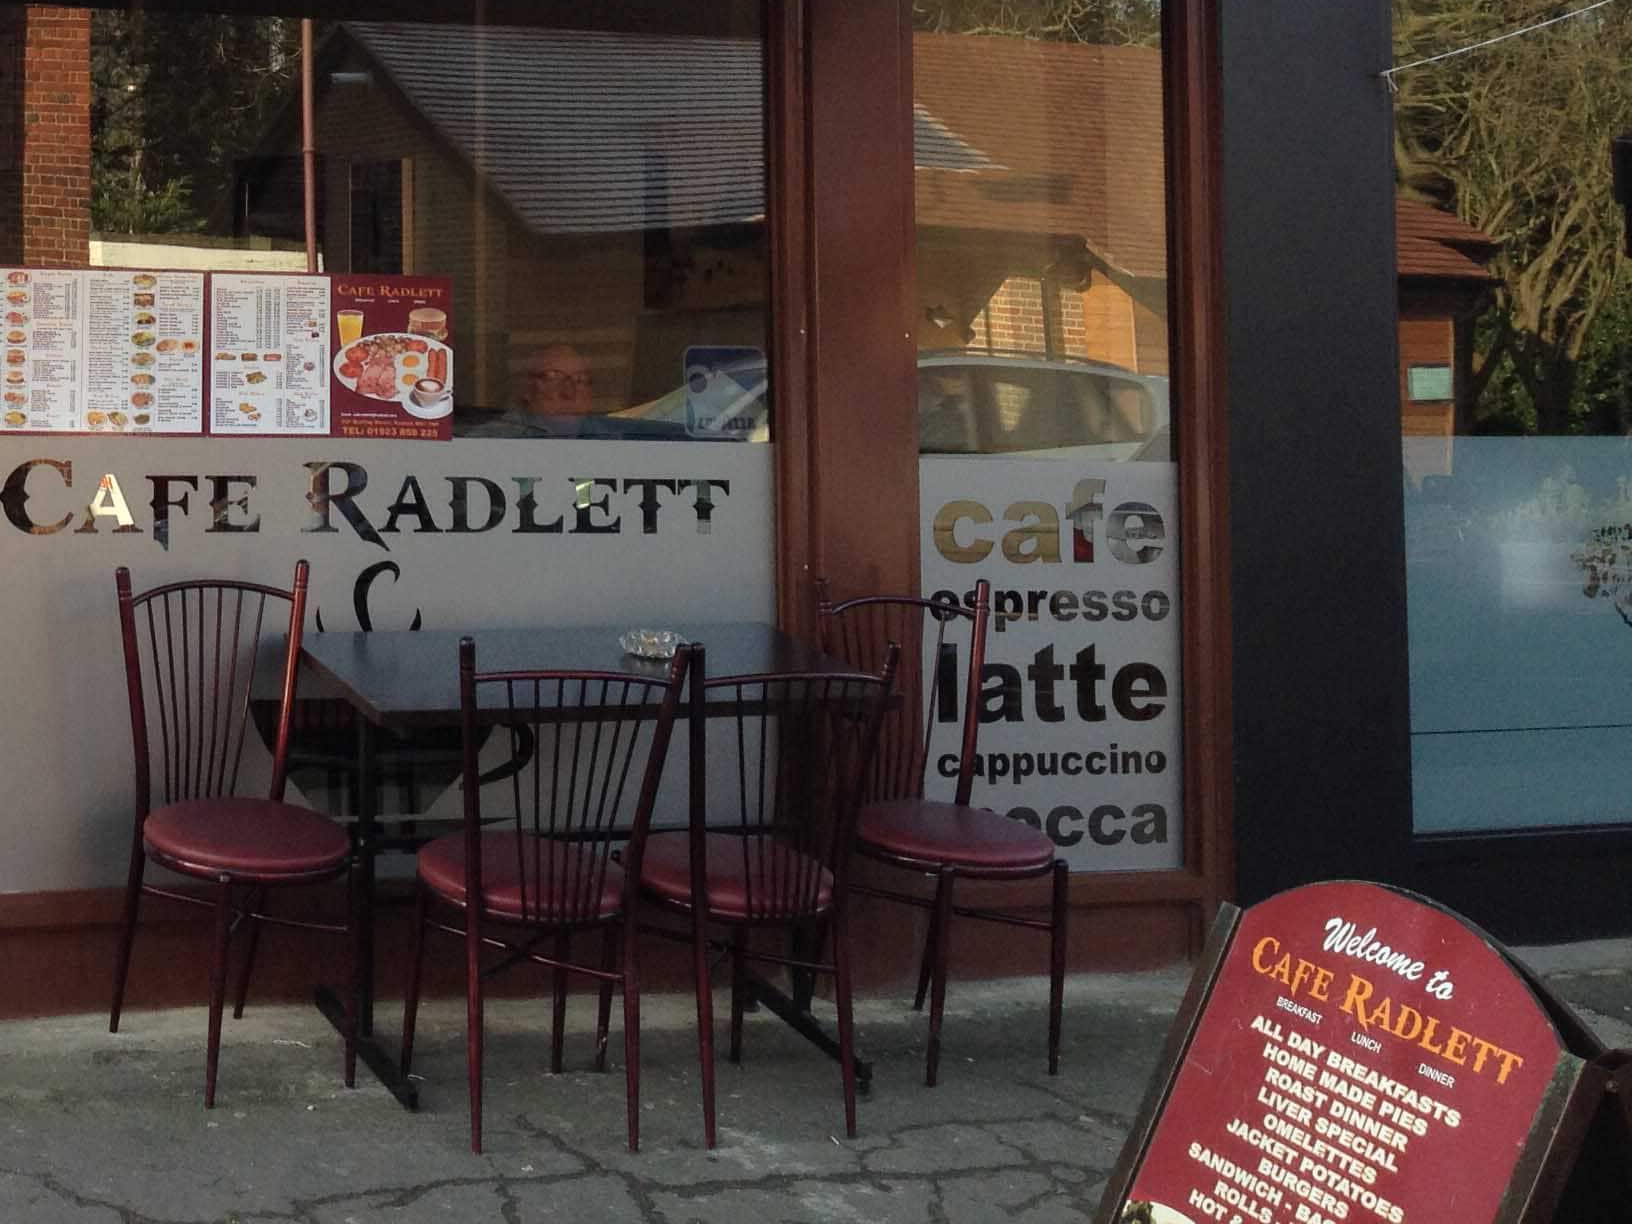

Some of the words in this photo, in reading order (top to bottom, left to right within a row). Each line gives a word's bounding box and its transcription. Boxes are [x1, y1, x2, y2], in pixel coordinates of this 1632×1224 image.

[300, 461, 730, 552] RADLETT
[933, 478, 1166, 565] cafe
[929, 588, 1170, 633] espresso
[938, 642, 1168, 723] latte
[1323, 917, 1425, 981] Welcome
[1425, 970, 1454, 1001] to
[1252, 936, 1335, 1003] CAFE
[1339, 974, 1524, 1085] RADLETT
[1276, 996, 1323, 1025] BREAKFAST
[1351, 1031, 1382, 1054] LUNCH
[1250, 1015, 1284, 1042] ALL
[1287, 1031, 1326, 1060] DAY
[1326, 1051, 1462, 1128] BREAKFASTS
[1262, 1042, 1318, 1081] HOME
[1318, 1070, 1377, 1110] MADE
[1378, 1100, 1428, 1137] PIES
[1265, 1067, 1328, 1108] ROAST
[1329, 1099, 1409, 1153] DINNER
[1418, 1063, 1455, 1089] DINNER
[1257, 1086, 1313, 1127] LIVER
[1314, 1117, 1398, 1174] SPECIAL
[1263, 1114, 1377, 1185] OMELETTES
[1187, 1142, 1283, 1207] SANDWICH
[1189, 1188, 1228, 1221] HOT
[1214, 1180, 1273, 1224] ROLLS
[1226, 1118, 1299, 1166] JACKET
[1299, 1155, 1405, 1224] POTATOES
[1257, 1157, 1349, 1219] BURGERS
